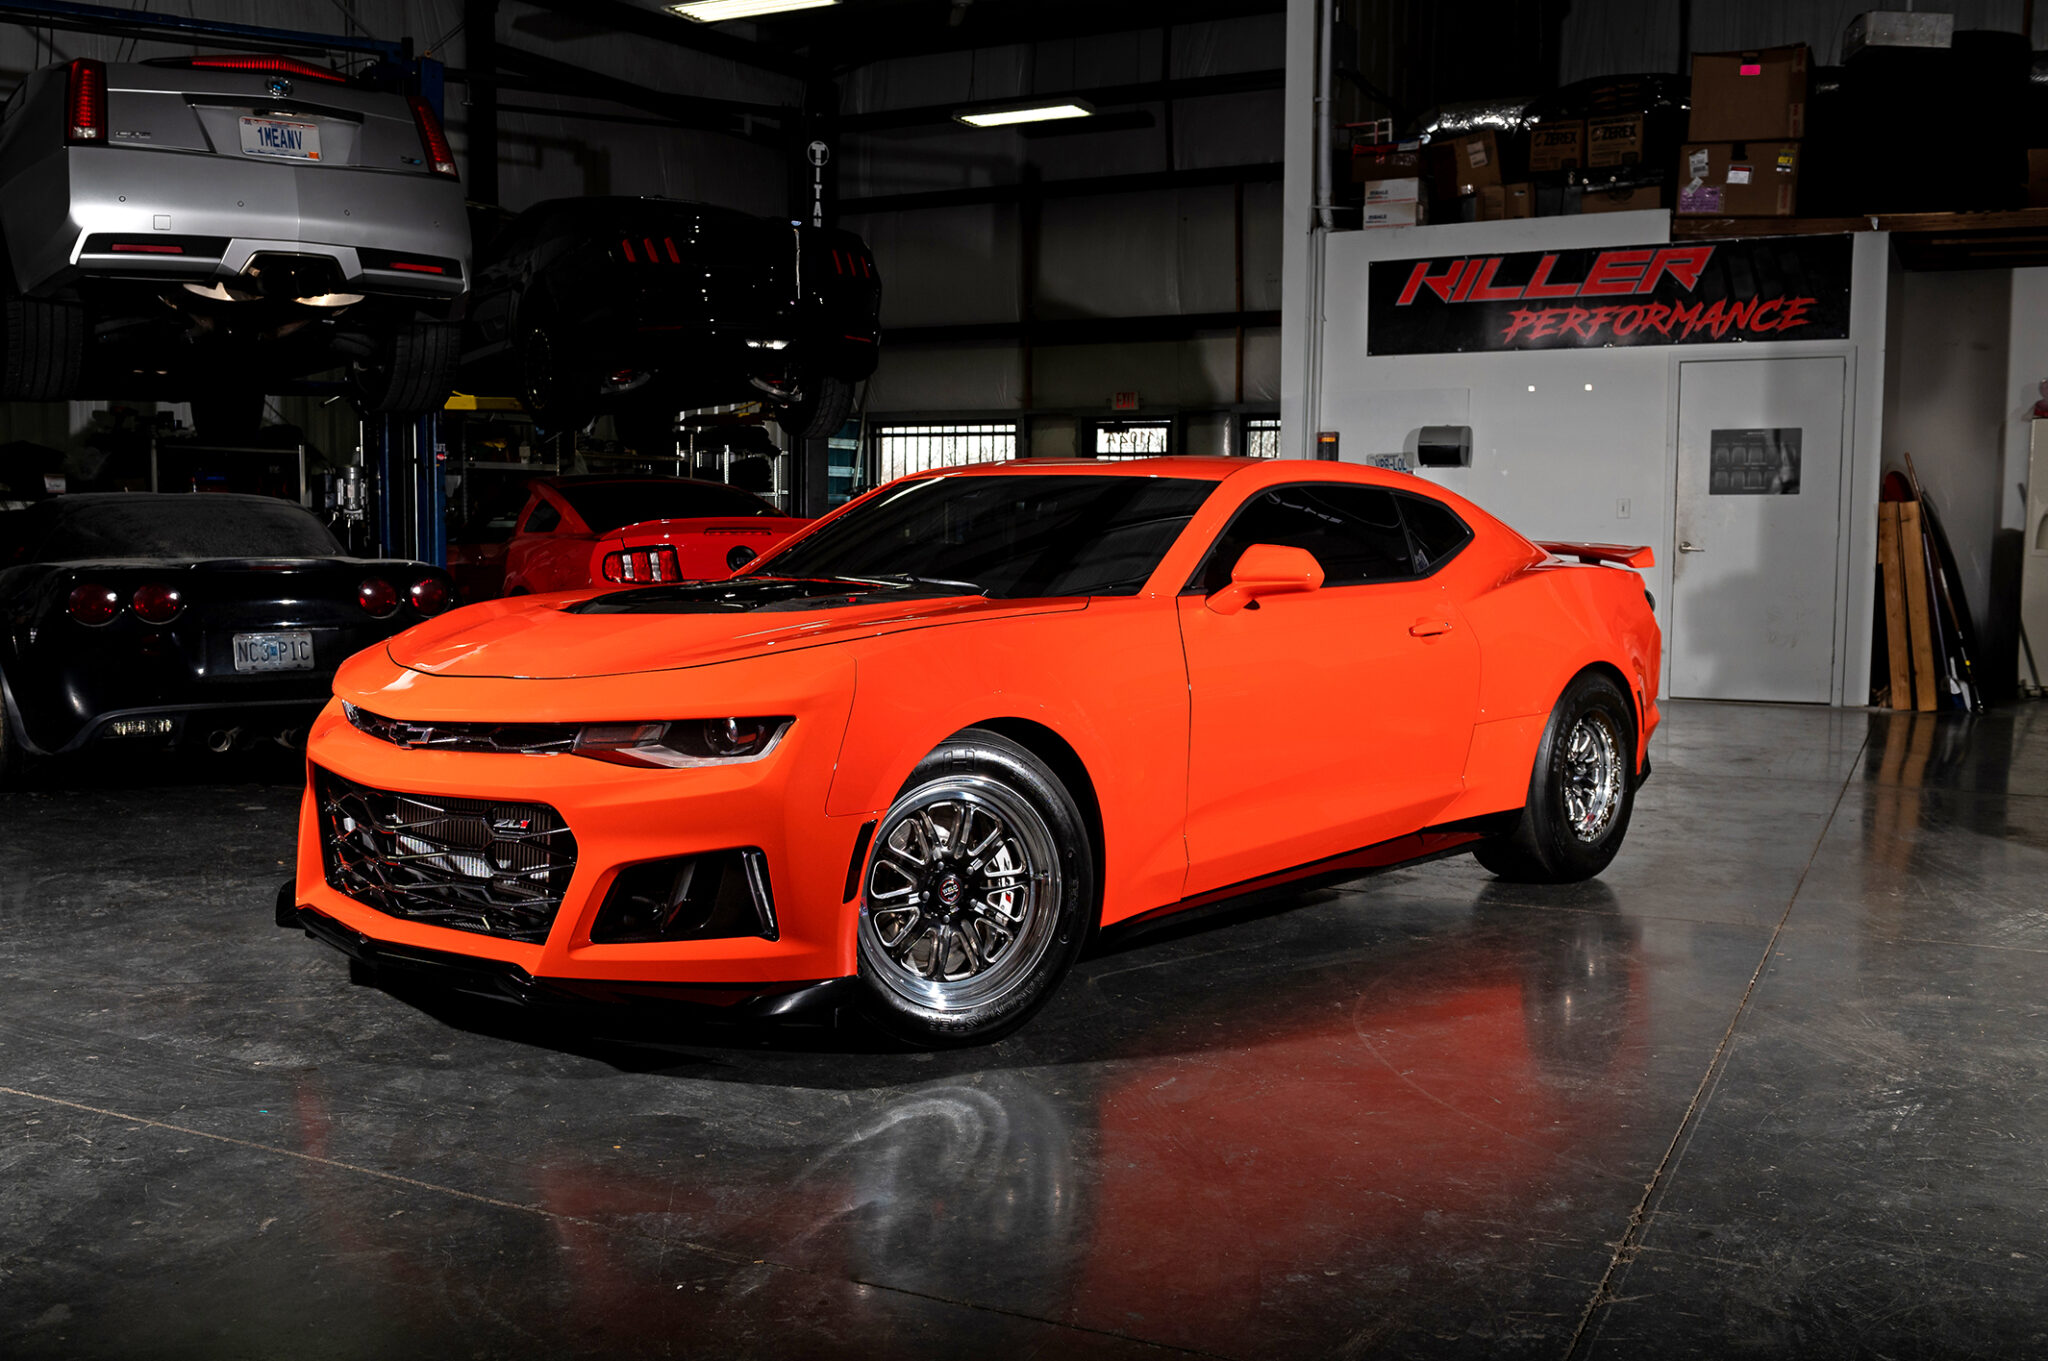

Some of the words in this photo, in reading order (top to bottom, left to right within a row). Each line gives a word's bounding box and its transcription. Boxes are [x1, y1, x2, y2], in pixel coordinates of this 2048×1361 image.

[257, 126, 302, 150] 1MEANV
[1544, 132, 1577, 146] ZEREX
[1602, 124, 1637, 140] ZEREX
[1395, 245, 1716, 306] KILLER
[1500, 294, 1817, 344] PERFORMANCE
[1116, 392, 1135, 408] EXIT
[494, 819, 530, 829] ZL1
